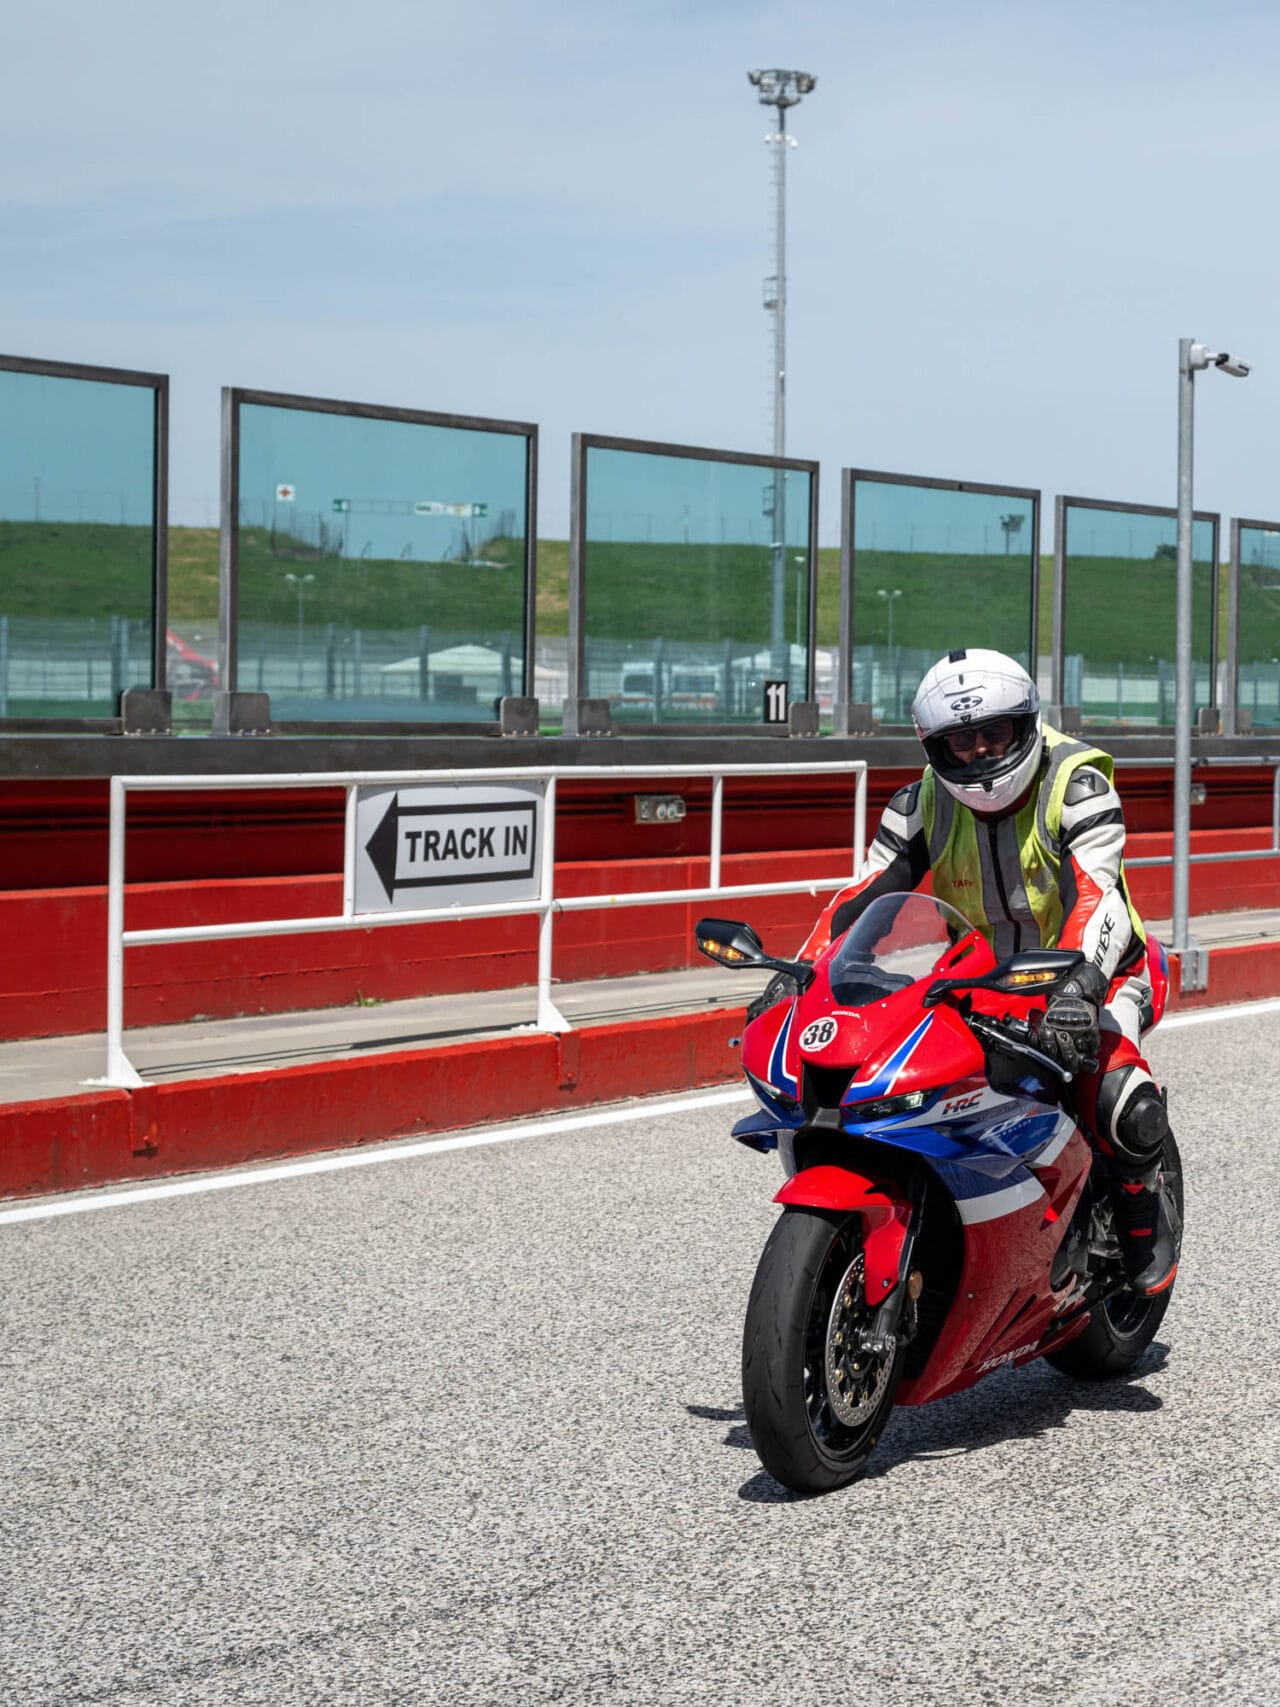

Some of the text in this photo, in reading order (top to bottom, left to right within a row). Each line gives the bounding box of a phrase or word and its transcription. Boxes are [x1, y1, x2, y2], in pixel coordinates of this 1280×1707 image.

[767, 683, 786, 721] 11
[405, 825, 528, 863] TRACK IN
[1093, 912, 1116, 967] INESE
[803, 1021, 834, 1046] 38
[942, 1092, 984, 1115] HRC
[976, 1340, 1039, 1374] HONDA
